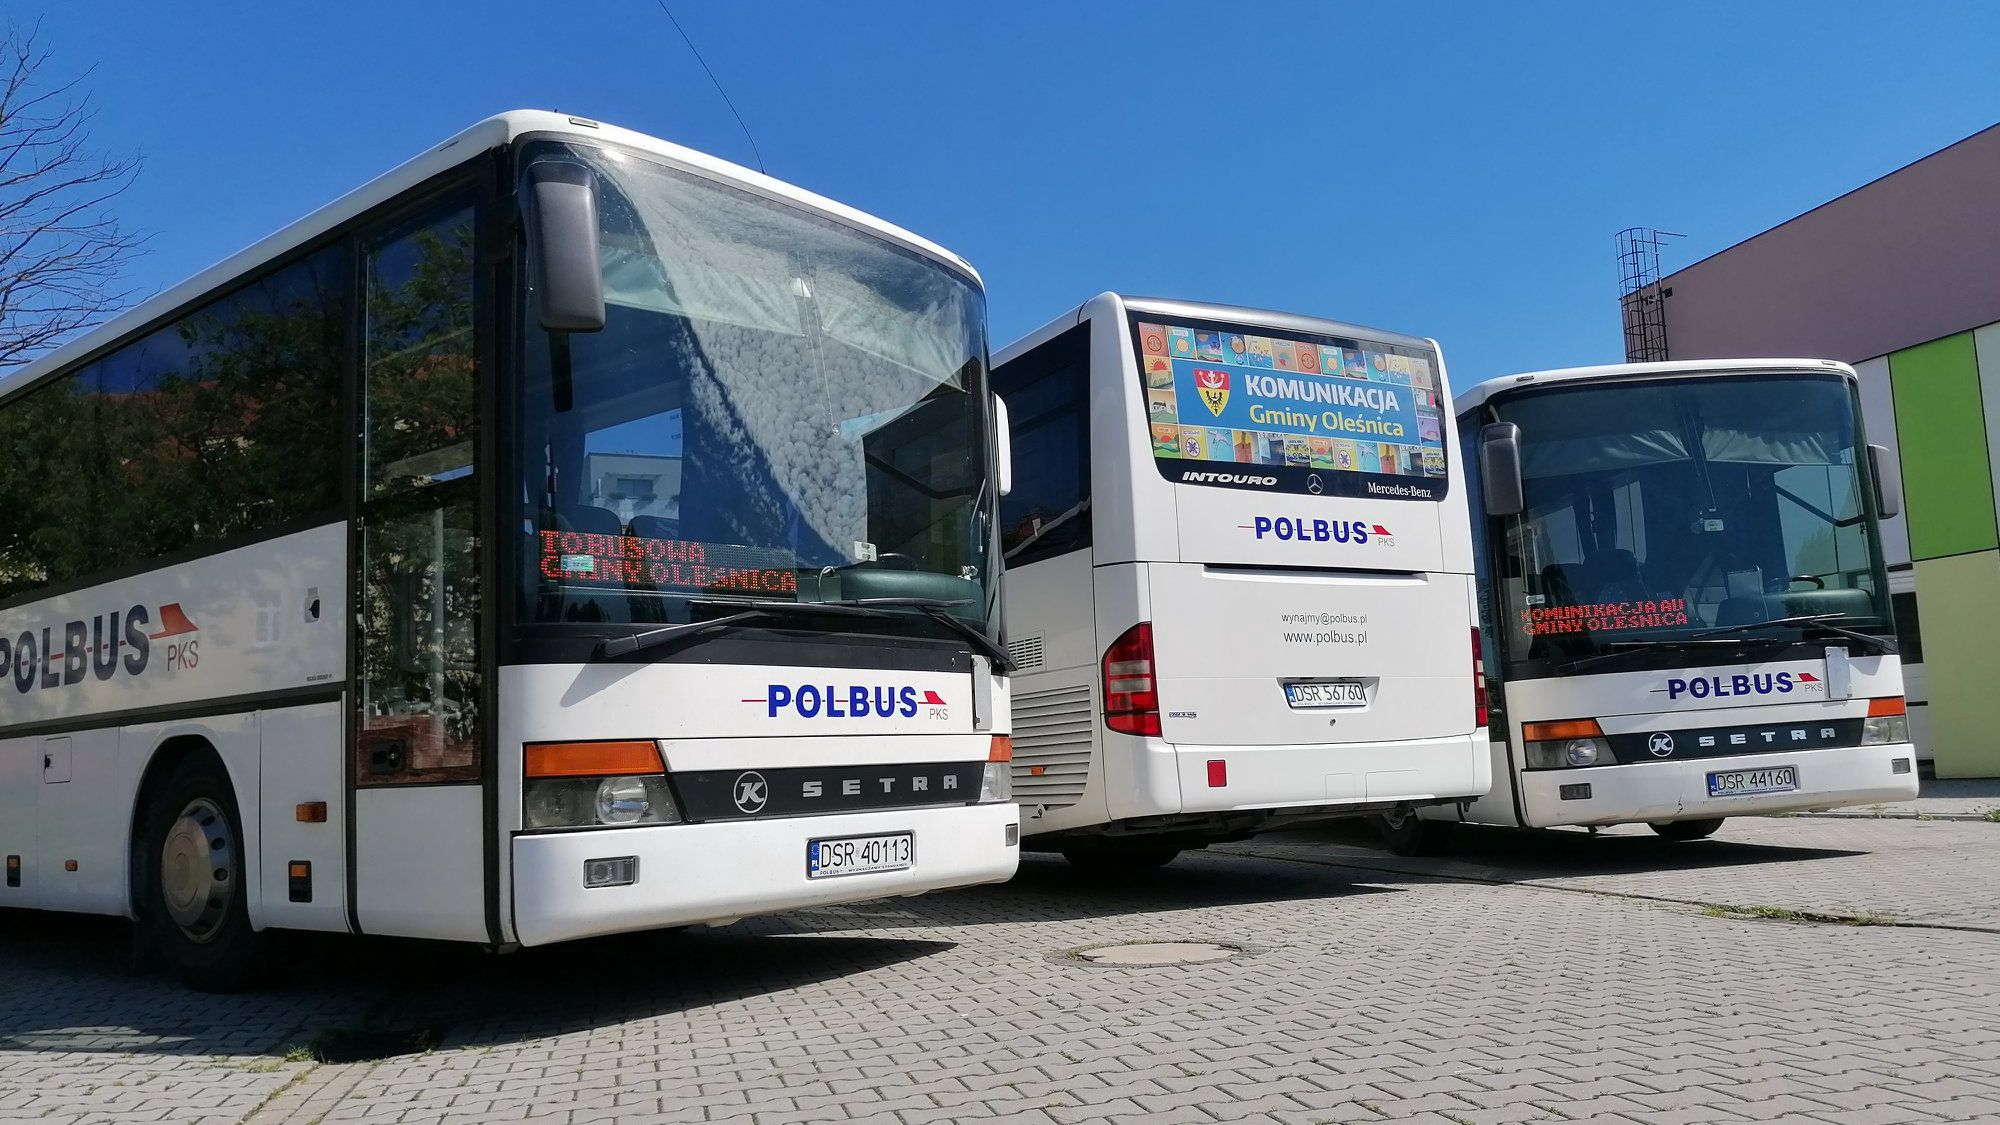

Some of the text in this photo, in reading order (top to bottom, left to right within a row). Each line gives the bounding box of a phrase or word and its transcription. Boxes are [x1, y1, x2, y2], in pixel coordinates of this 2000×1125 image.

[1245, 374, 1400, 414] KOMUNIKACJA
[1250, 404, 1405, 437] Gminy Oleśnica
[1182, 471, 1278, 486] INTOURO
[1367, 482, 1432, 498] Mercedes-Benz
[1255, 516, 1368, 544] POLBUS
[539, 530, 706, 563] TOBUSOWA
[1378, 538, 1395, 547] PKS
[1281, 612, 1368, 625] wynajmy@polbus.pl
[1283, 630, 1368, 645] www.polbus.pl
[167, 640, 199, 672] PKS
[1294, 686, 1321, 701] DSR
[1323, 685, 1363, 701] 56760
[1668, 672, 1794, 699] POLBUS
[1804, 684, 1823, 692] PKS
[767, 684, 919, 718] POLBUS
[929, 708, 949, 721] PKS
[1699, 728, 1836, 747] SETRA
[802, 774, 959, 798] SETRA
[1717, 770, 1792, 790] DSR 44160
[821, 838, 909, 868] DSR 40113
